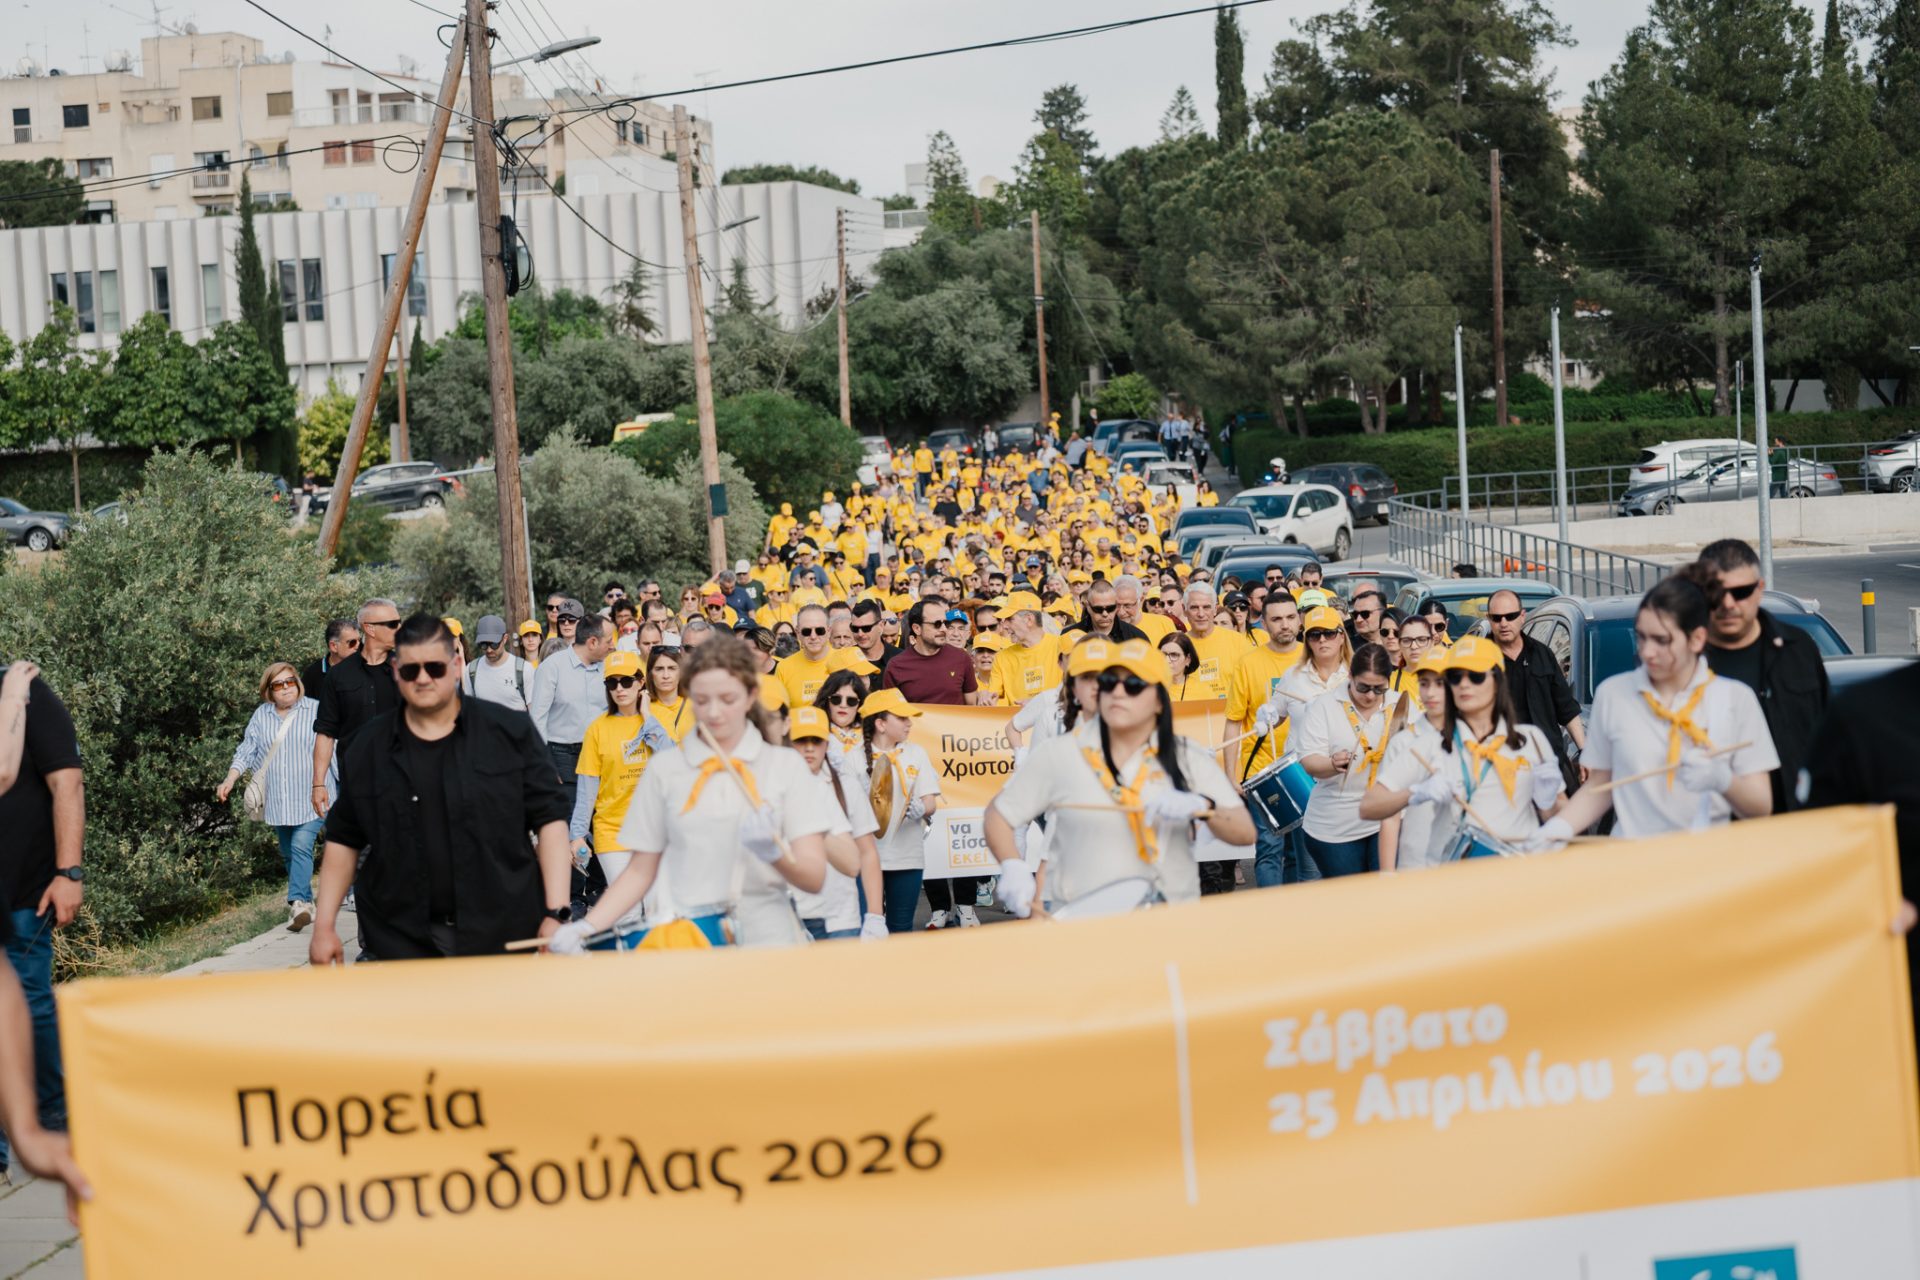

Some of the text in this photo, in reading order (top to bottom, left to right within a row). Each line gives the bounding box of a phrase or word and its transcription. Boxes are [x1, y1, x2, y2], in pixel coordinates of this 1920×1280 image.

[942, 755, 1015, 782] Χριστο
[950, 823, 971, 834] να
[951, 835, 988, 850] είσα
[1263, 1003, 1508, 1072] Σάββατο
[236, 1067, 486, 1157] Πορεία
[1267, 1030, 1783, 1140] 25 Απριλίου 2026
[241, 1111, 944, 1249] Χριστοδούλας 2026
